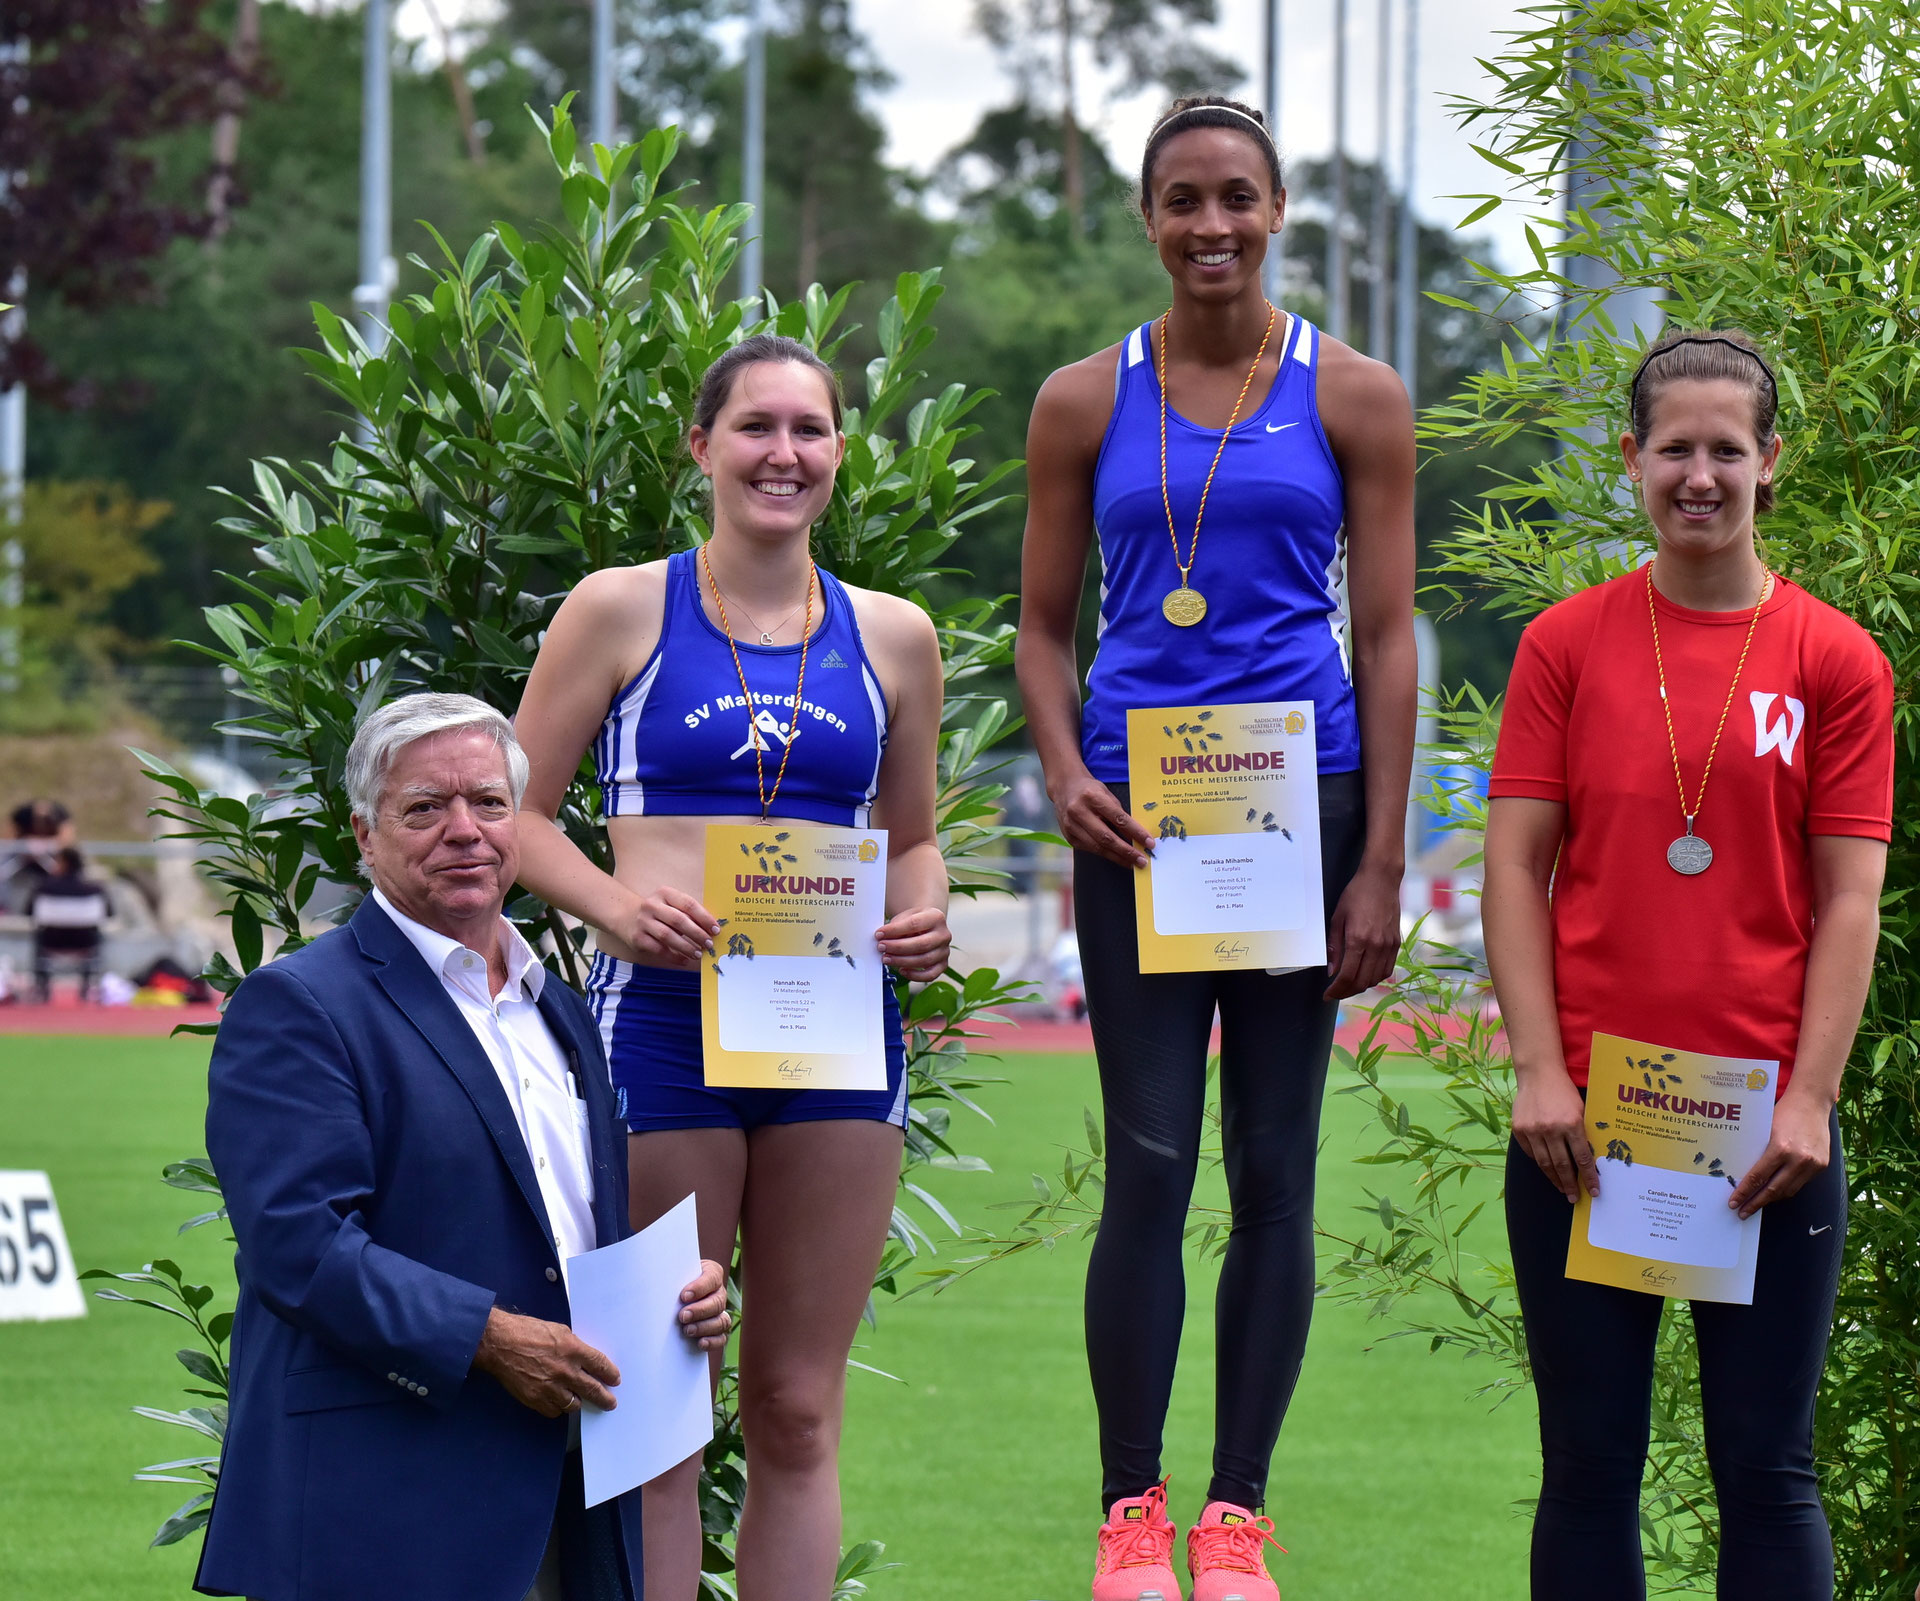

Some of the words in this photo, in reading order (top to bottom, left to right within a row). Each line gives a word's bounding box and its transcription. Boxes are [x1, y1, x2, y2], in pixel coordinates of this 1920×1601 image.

[820, 660, 848, 668] adidas
[684, 704, 710, 728] SV
[716, 692, 847, 733] Malterdingen
[1160, 751, 1284, 775] URKUNDE
[1209, 774, 1286, 783] MEISTERSCHAFTEN
[735, 874, 855, 895] URKUNDE
[1618, 1084, 1742, 1122] URKUNDE
[1616, 1105, 1657, 1119] BADISCHE
[1662, 1115, 1740, 1131] MEISTERSCHAFTEN
[1616, 1118, 1635, 1127] Männer,
[1636, 1123, 1654, 1131] Frauen,
[1632, 1127, 1645, 1135] 2017,
[1646, 1130, 1676, 1140] Waldstadion
[1676, 1136, 1698, 1144] Walldorf
[1648, 1189, 1668, 1197] Carolin
[1656, 1216, 1682, 1225] Weitsprung
